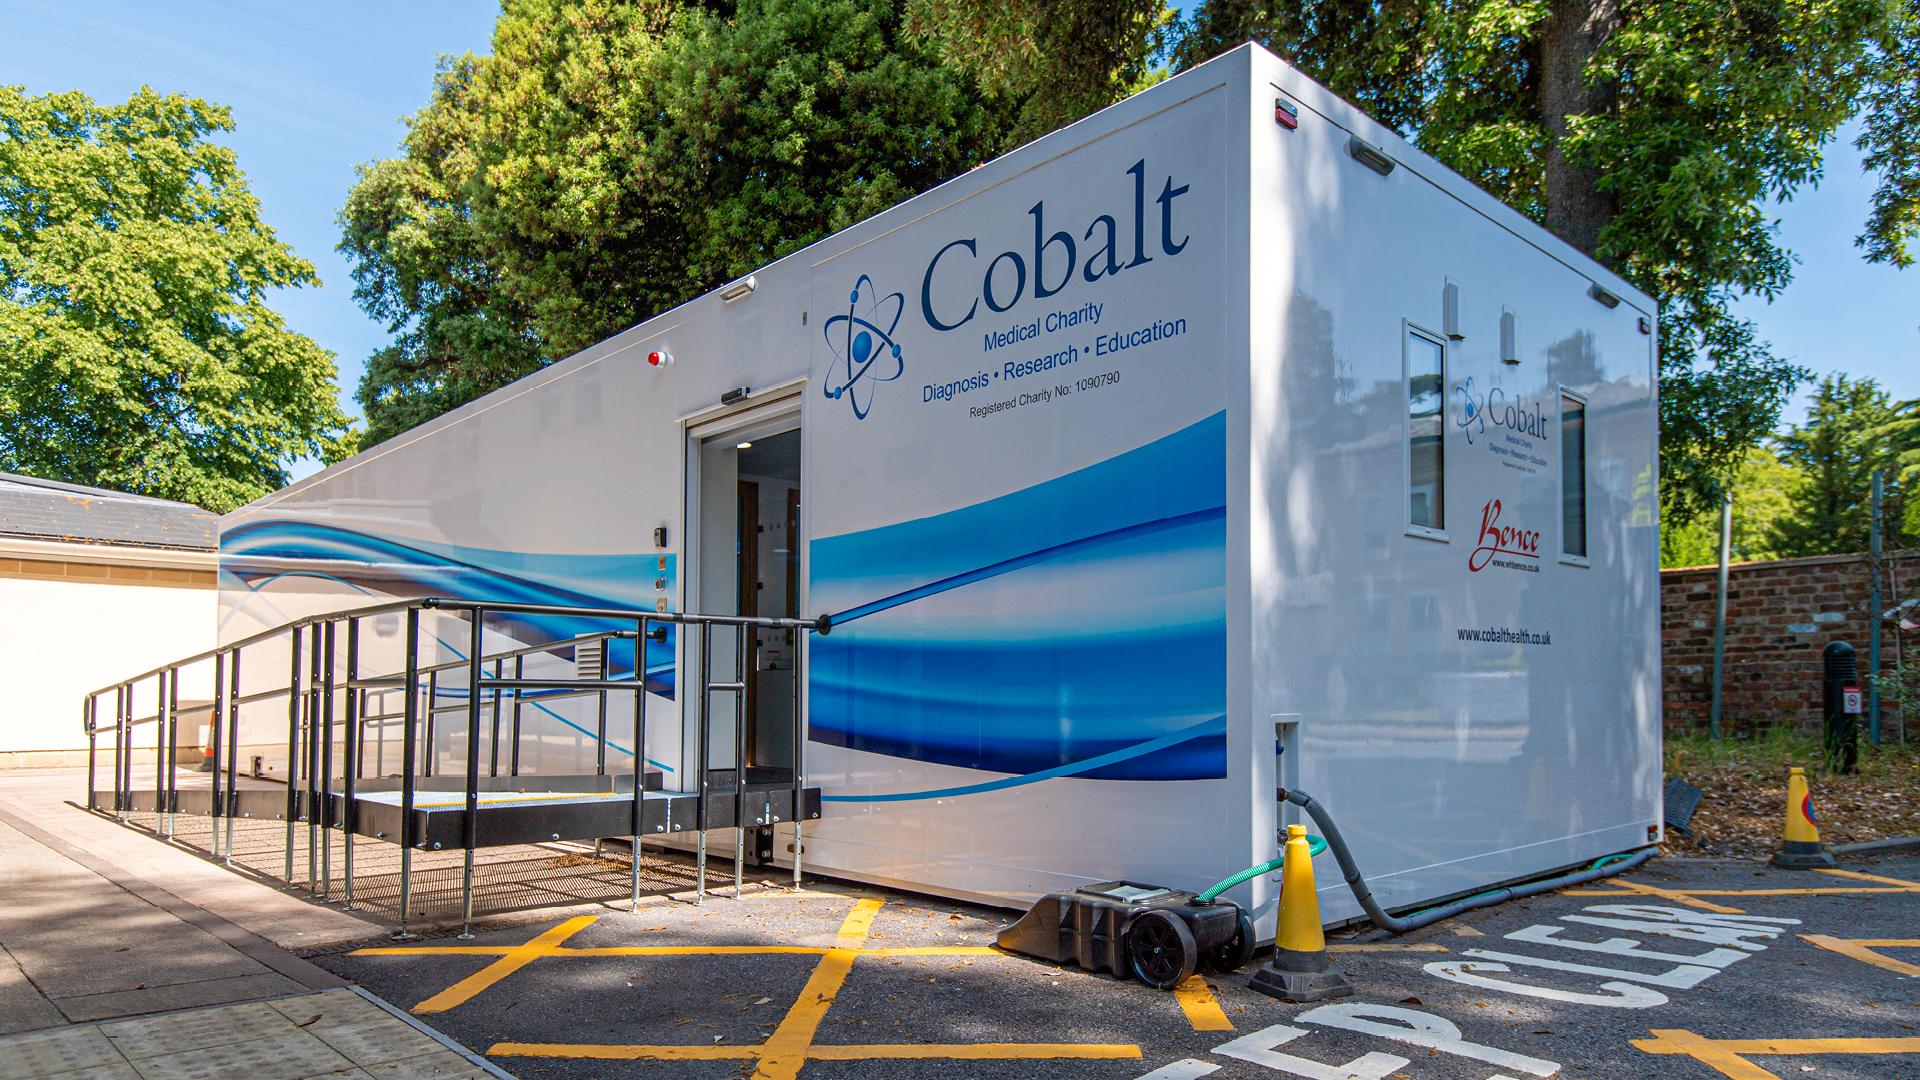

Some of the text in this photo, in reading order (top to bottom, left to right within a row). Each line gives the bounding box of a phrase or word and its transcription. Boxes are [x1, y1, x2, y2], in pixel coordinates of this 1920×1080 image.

[921, 158, 1190, 332] Cobalt
[984, 301, 1104, 352] Medical Charity
[923, 317, 1187, 403] Diagnosis Research Education
[969, 371, 1121, 418] Registered Charity No: 1090790
[1488, 387, 1547, 440] Cobalt
[1469, 497, 1540, 572] Bence
[1457, 626, 1552, 646] www.cobalthealth.co.uk
[1134, 905, 1802, 1080] EP CLEAR
